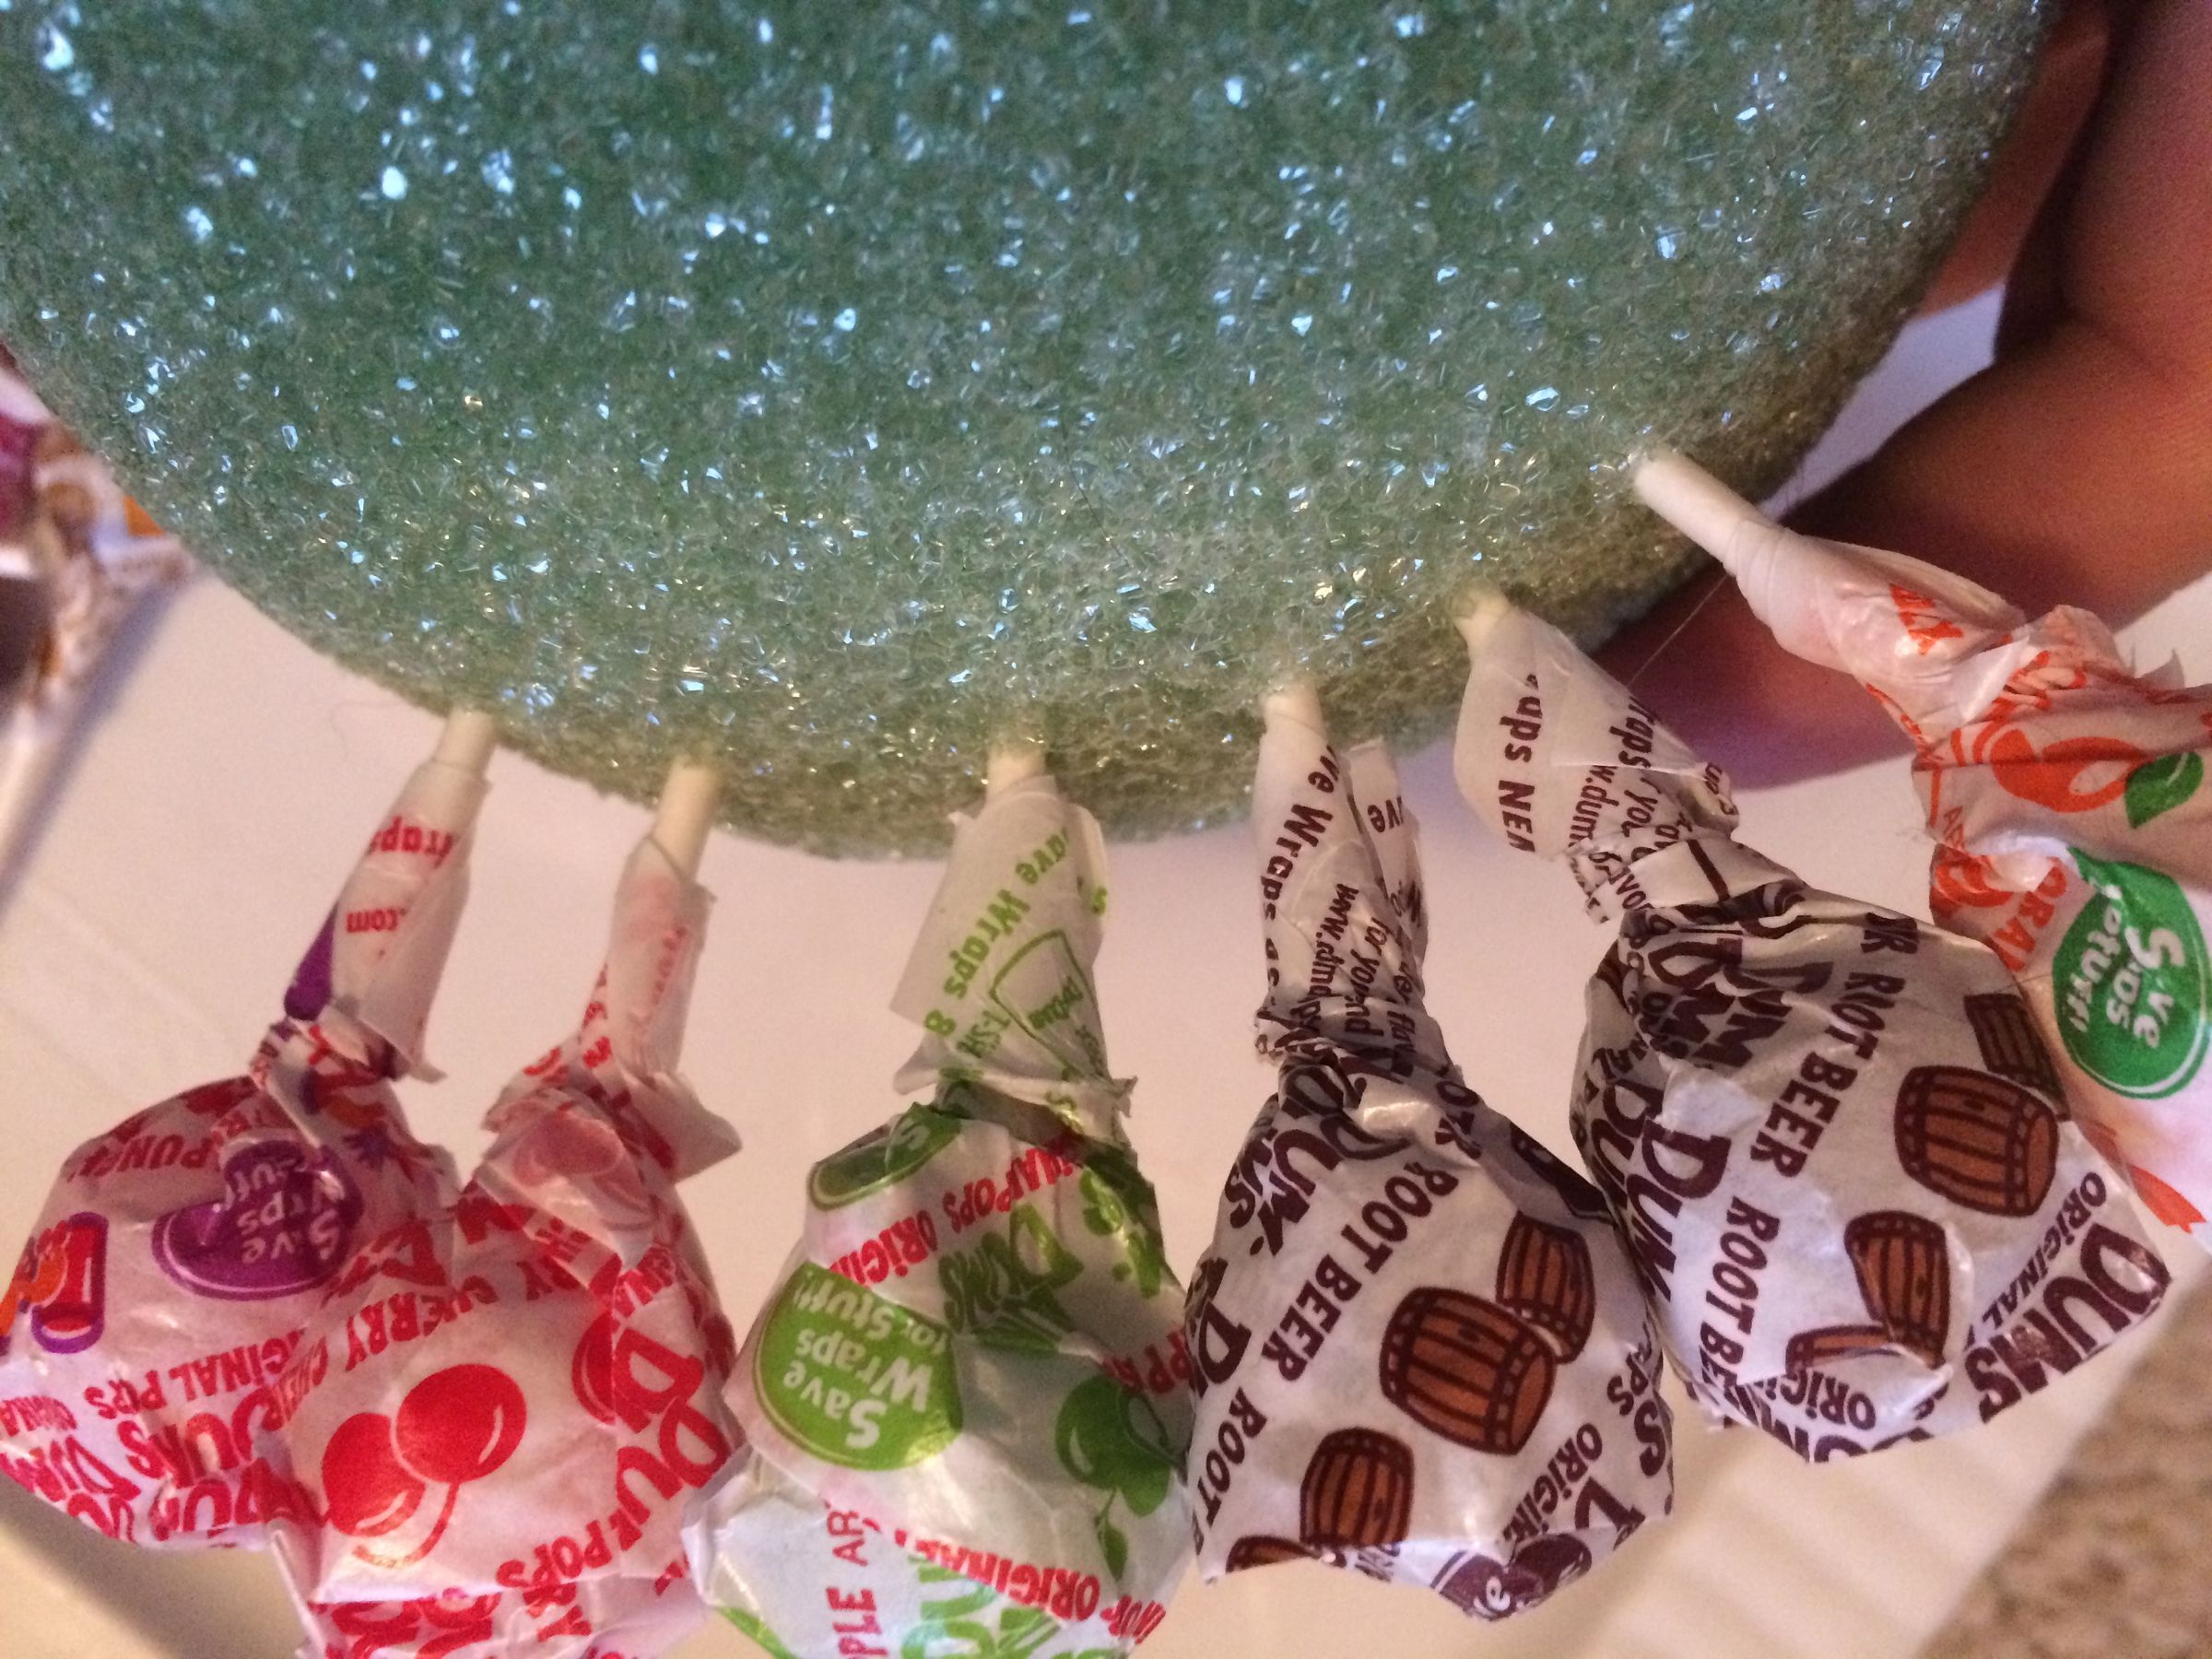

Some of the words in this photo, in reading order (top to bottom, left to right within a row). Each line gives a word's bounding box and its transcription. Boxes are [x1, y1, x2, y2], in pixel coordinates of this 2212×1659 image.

[943, 888, 1032, 1000] Wraps
[1749, 1051, 1859, 1179] BEER
[1339, 1161, 1460, 1276] ROOT
[1704, 1195, 1782, 1335] ROOT
[797, 1328, 935, 1412] Wraps
[1260, 1253, 1363, 1382] BEER
[1964, 1221, 2173, 1425] DUMS
[782, 1358, 888, 1450] Save
[1194, 1387, 1268, 1529] ROOT
